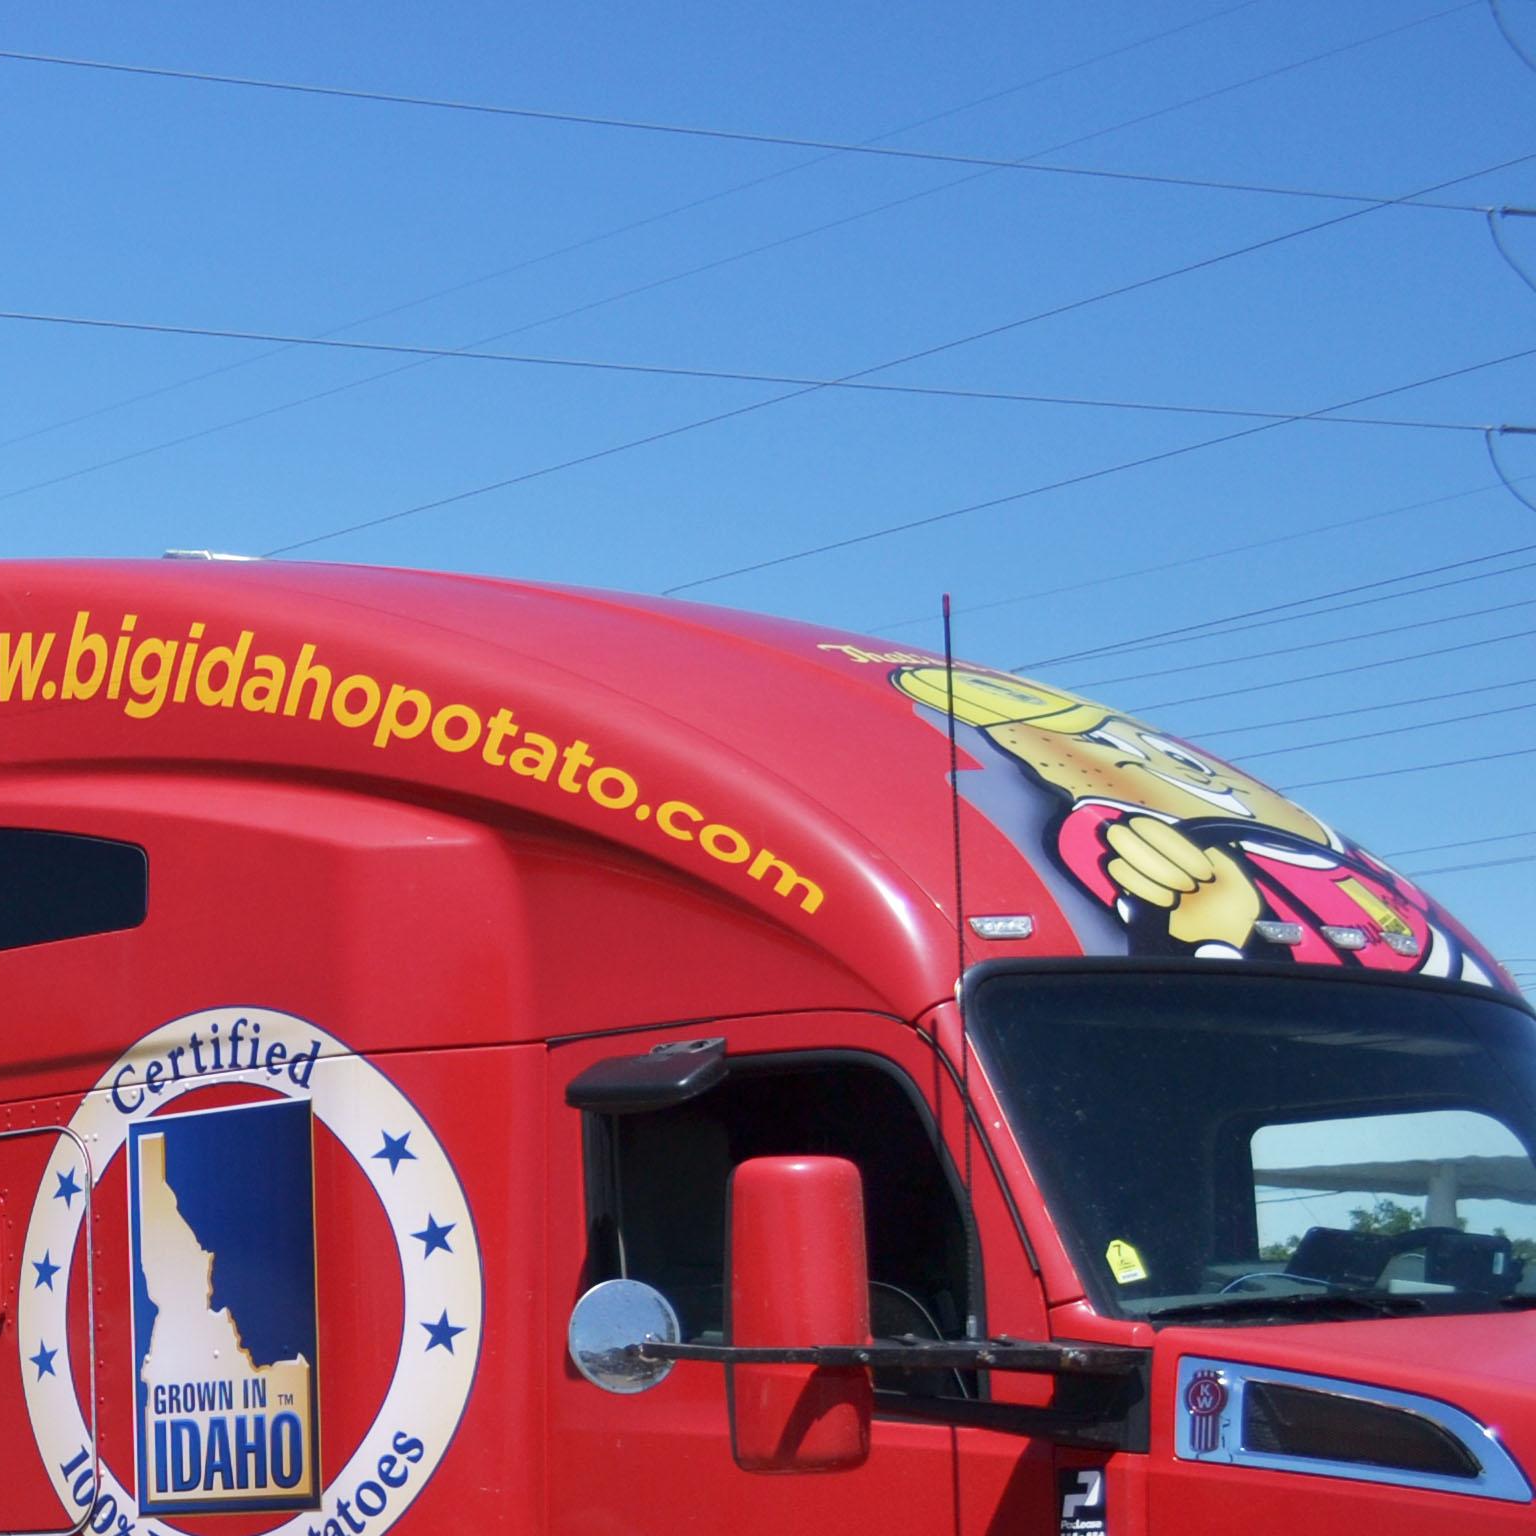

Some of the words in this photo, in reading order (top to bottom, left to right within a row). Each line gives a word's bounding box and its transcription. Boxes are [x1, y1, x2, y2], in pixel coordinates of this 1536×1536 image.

[110, 1018, 323, 1116] Certified
[154, 1379, 234, 1414] GROWN
[242, 1377, 267, 1410] IN
[154, 1413, 304, 1494] IDAHO
